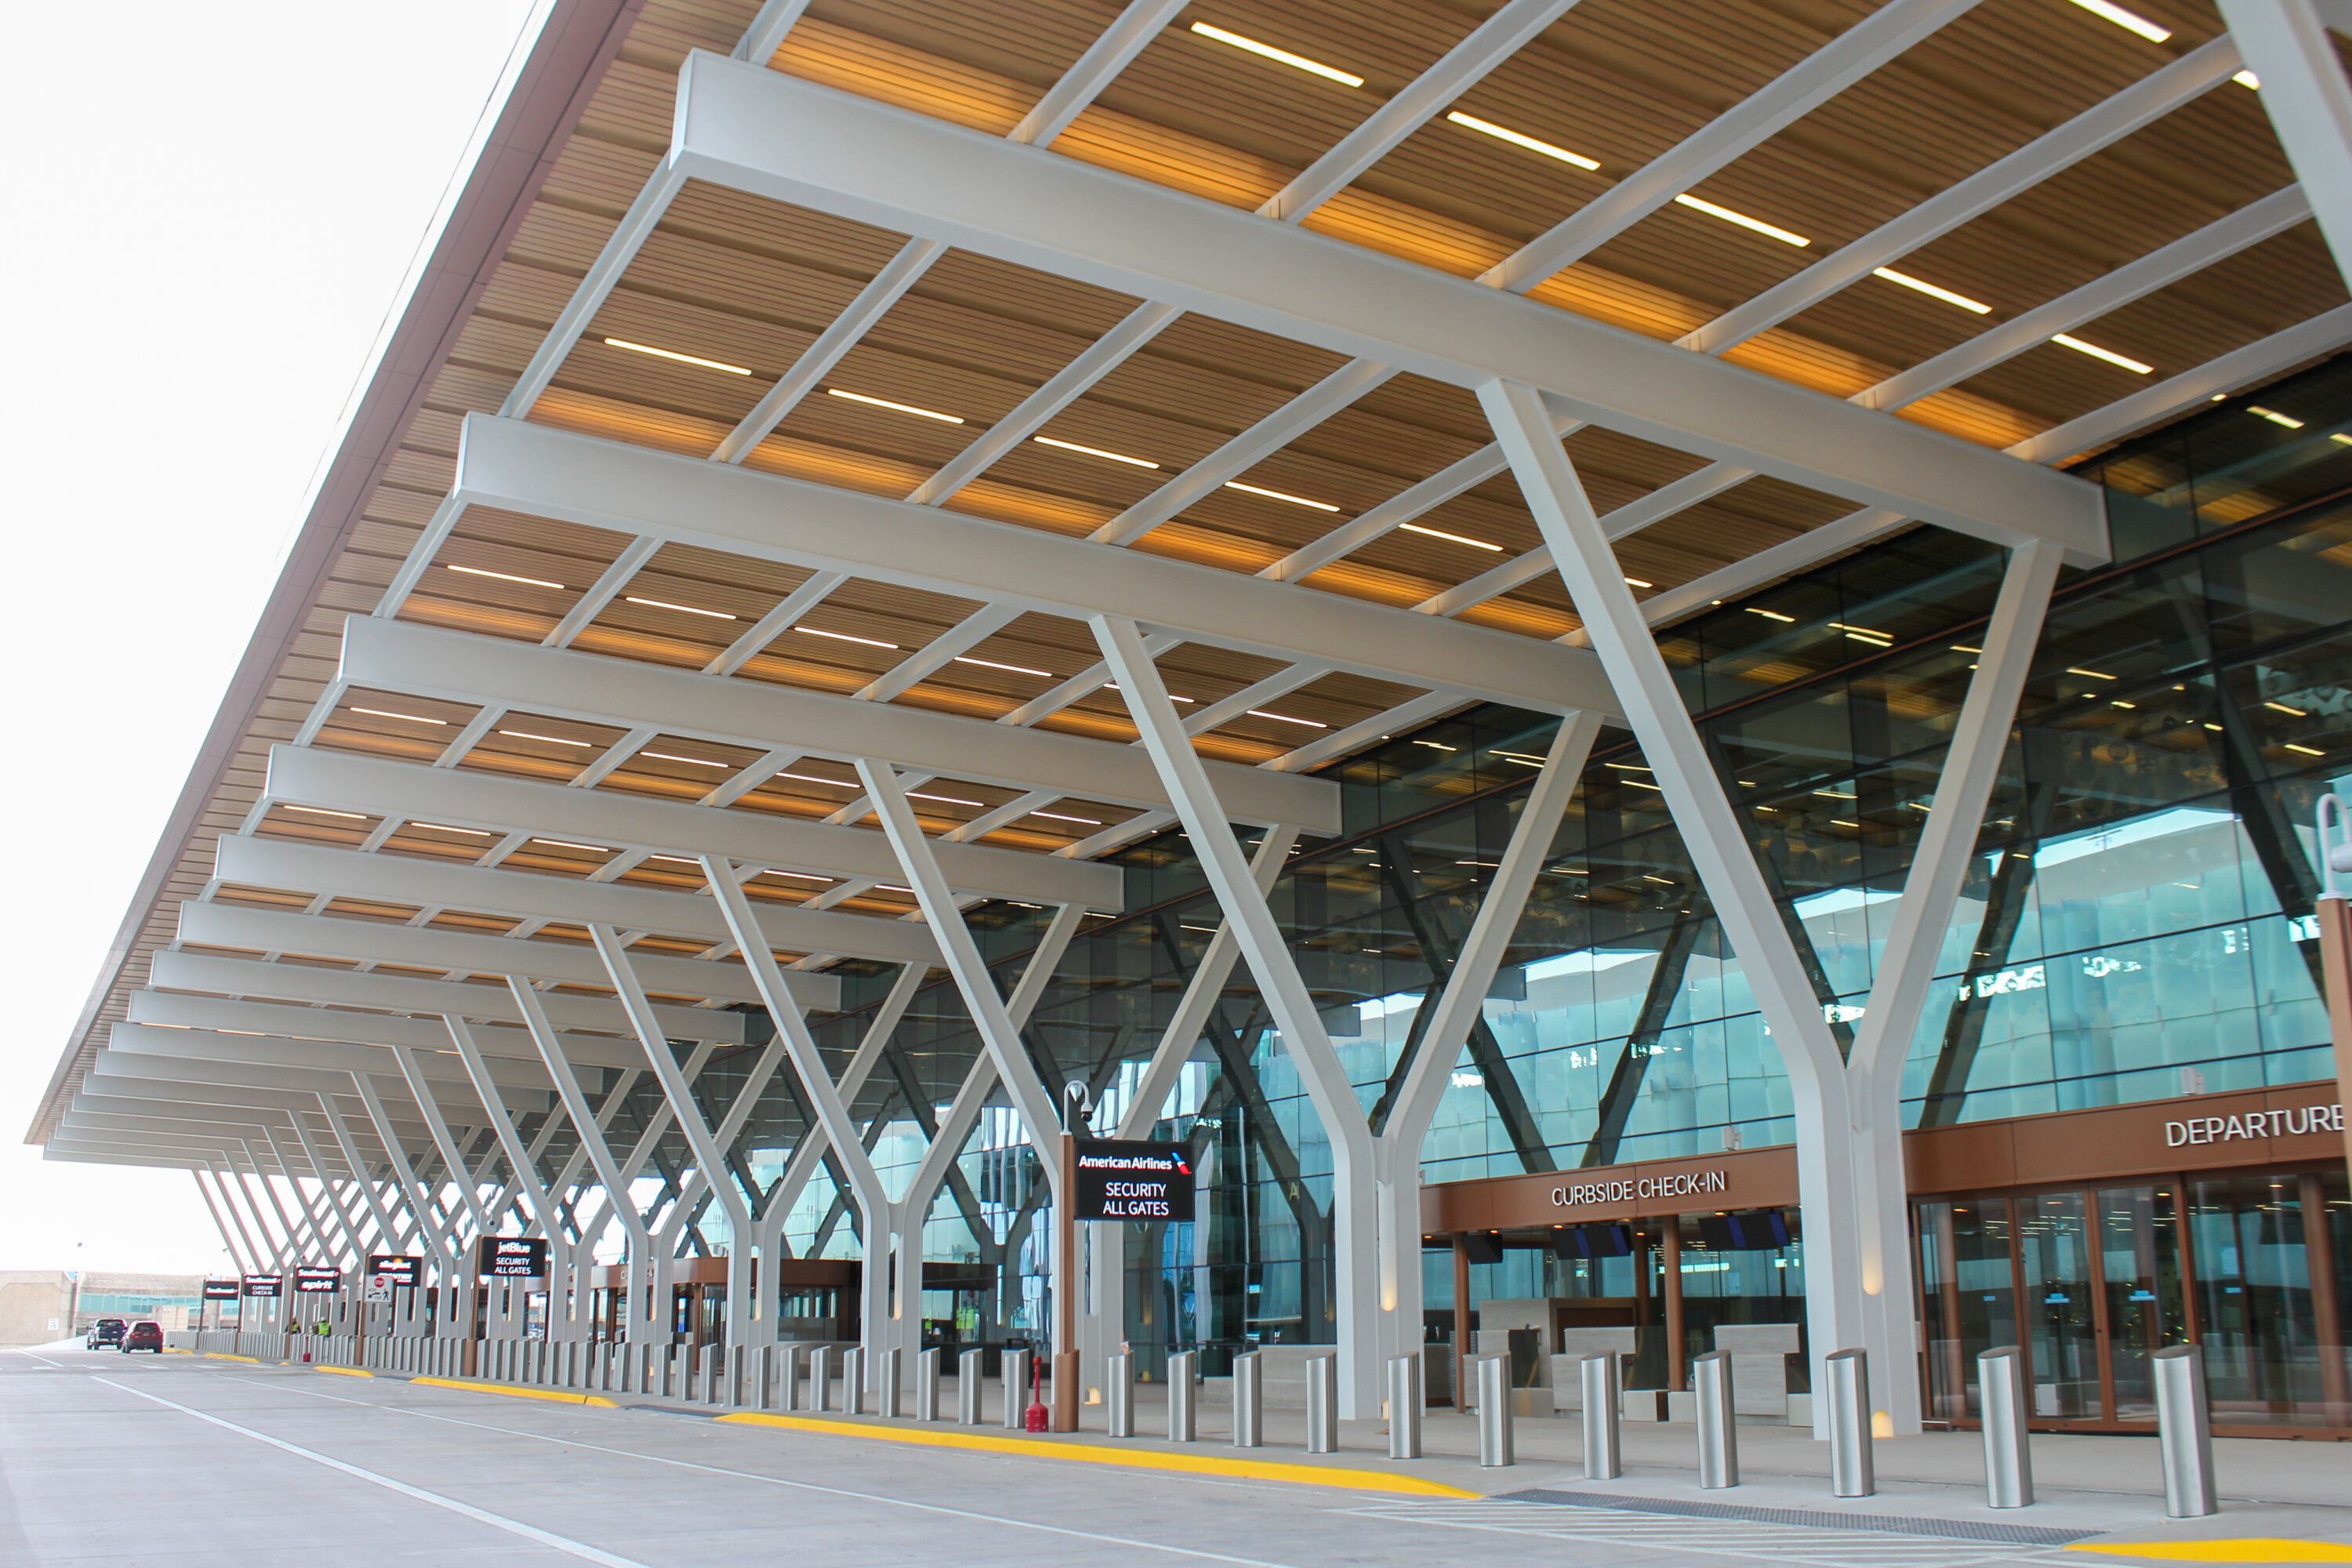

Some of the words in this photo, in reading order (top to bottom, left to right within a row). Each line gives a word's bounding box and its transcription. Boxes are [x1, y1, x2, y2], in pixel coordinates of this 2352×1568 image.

[2165, 1104, 2346, 1147] DEPARTURE
[1079, 1155, 1131, 1169] American
[1131, 1156, 1173, 1171] Airlines
[1105, 1182, 1167, 1197] SECURITY
[1552, 1180, 1635, 1207] CURBSIDE
[1638, 1171, 1726, 1199] CHECK-IN
[1102, 1200, 1126, 1215] ALL
[1128, 1200, 1169, 1216] GATES
[497, 1241, 532, 1255] jetBlue
[495, 1257, 531, 1265] SECURITY
[298, 1269, 335, 1278] Southwest
[508, 1266, 532, 1275] GATES
[301, 1279, 333, 1290] spirit
